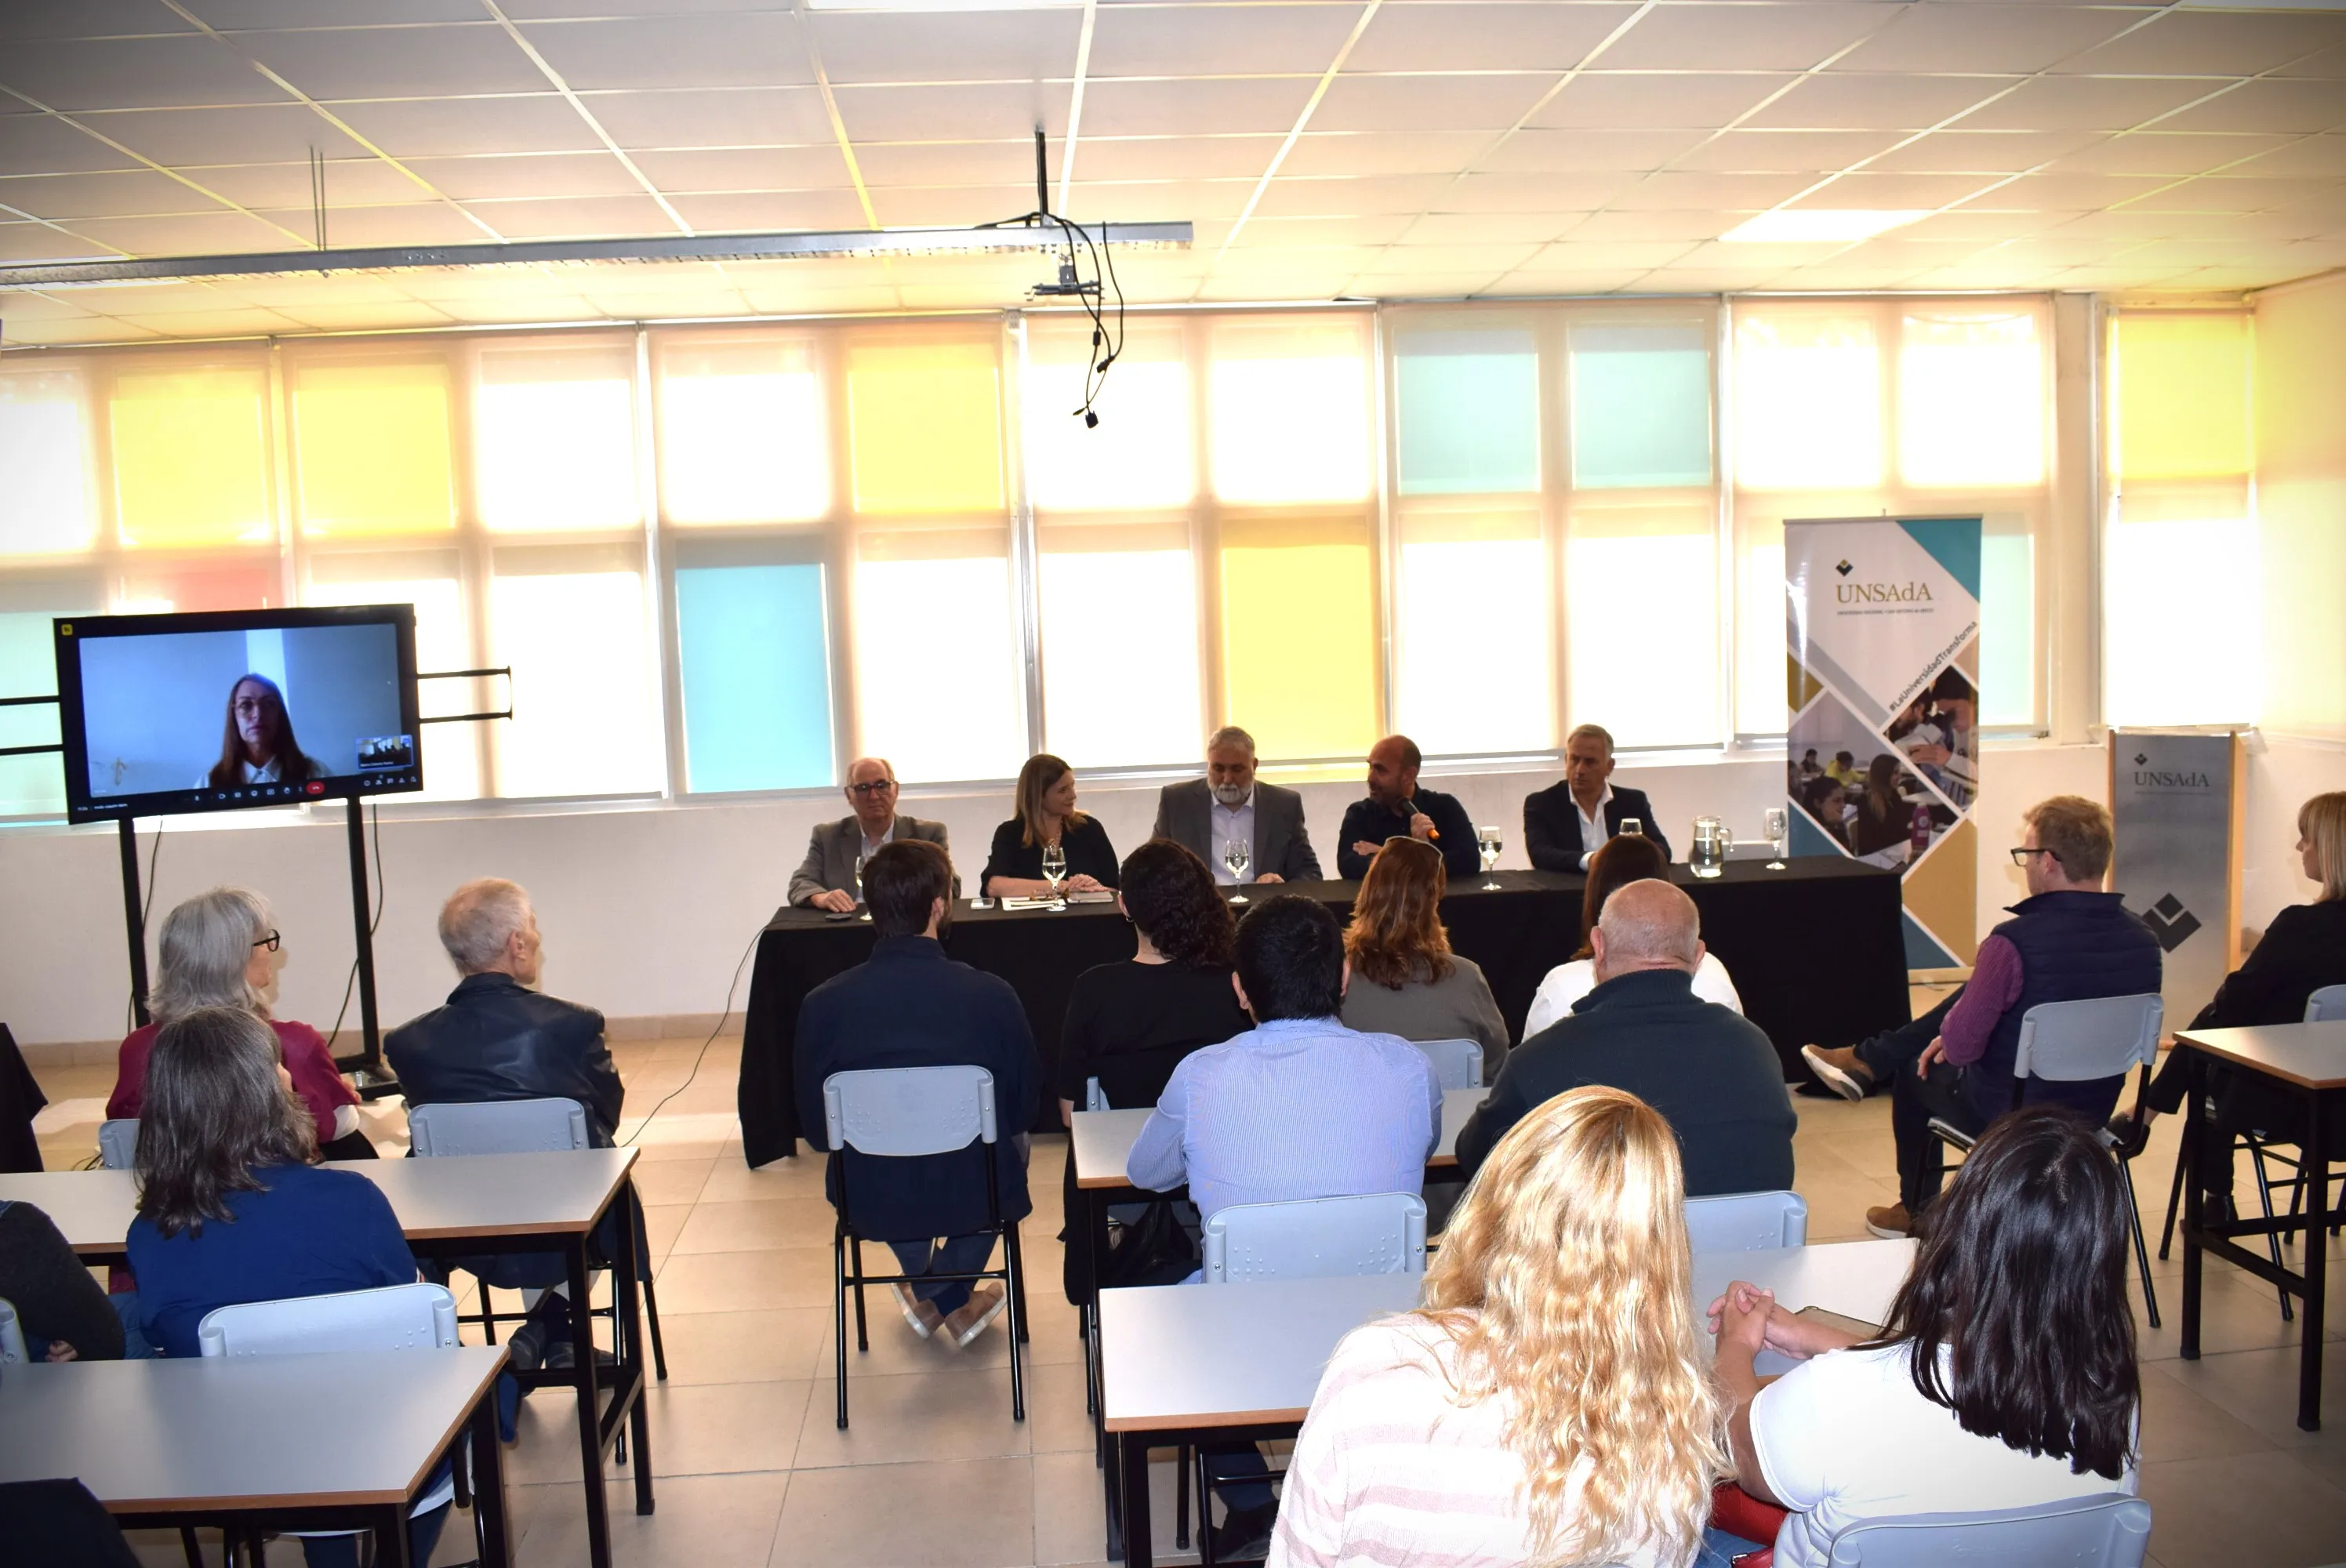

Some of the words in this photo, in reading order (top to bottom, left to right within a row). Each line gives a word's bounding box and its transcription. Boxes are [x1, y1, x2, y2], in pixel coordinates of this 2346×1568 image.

[1836, 581, 1934, 604] UNSAdA
[1889, 621, 1977, 710] #LaUniversidadTransforma
[2134, 771, 2210, 787] UNSAdA
